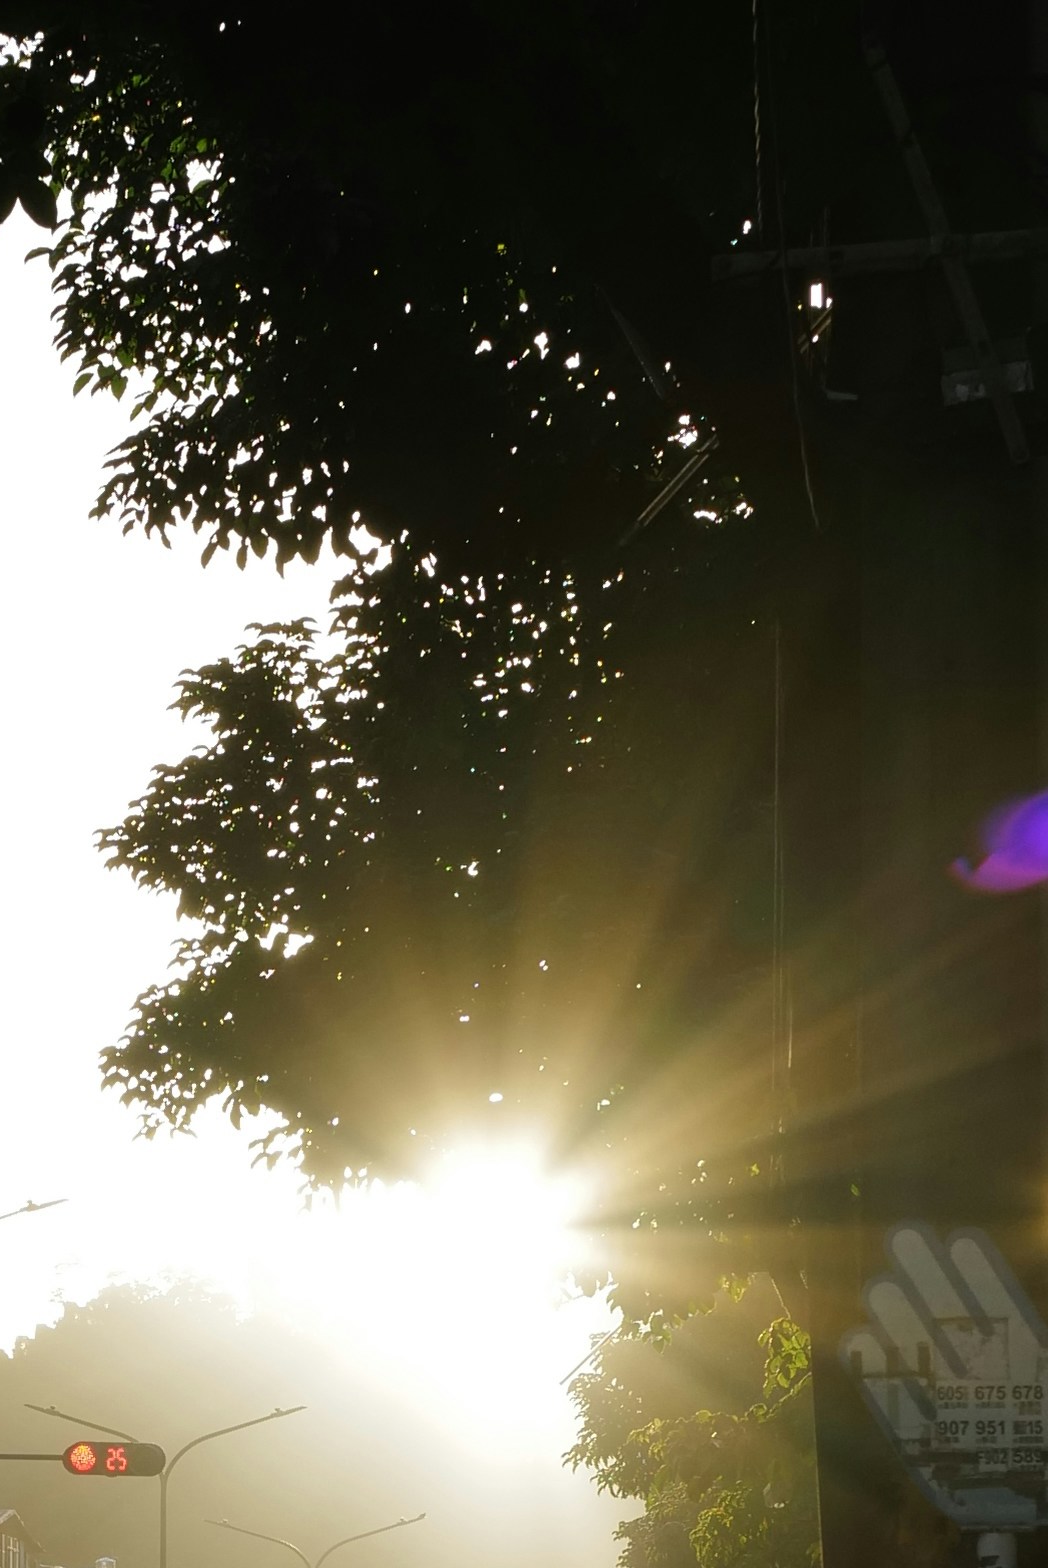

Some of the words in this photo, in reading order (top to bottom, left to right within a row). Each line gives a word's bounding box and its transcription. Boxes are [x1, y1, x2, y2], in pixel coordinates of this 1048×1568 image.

[937, 1386, 964, 1400] 605
[975, 1385, 1007, 1400] 675
[1012, 1385, 1044, 1400] 678
[938, 1420, 970, 1435] 907
[975, 1420, 1006, 1435] 951
[106, 1447, 127, 1471] 25
